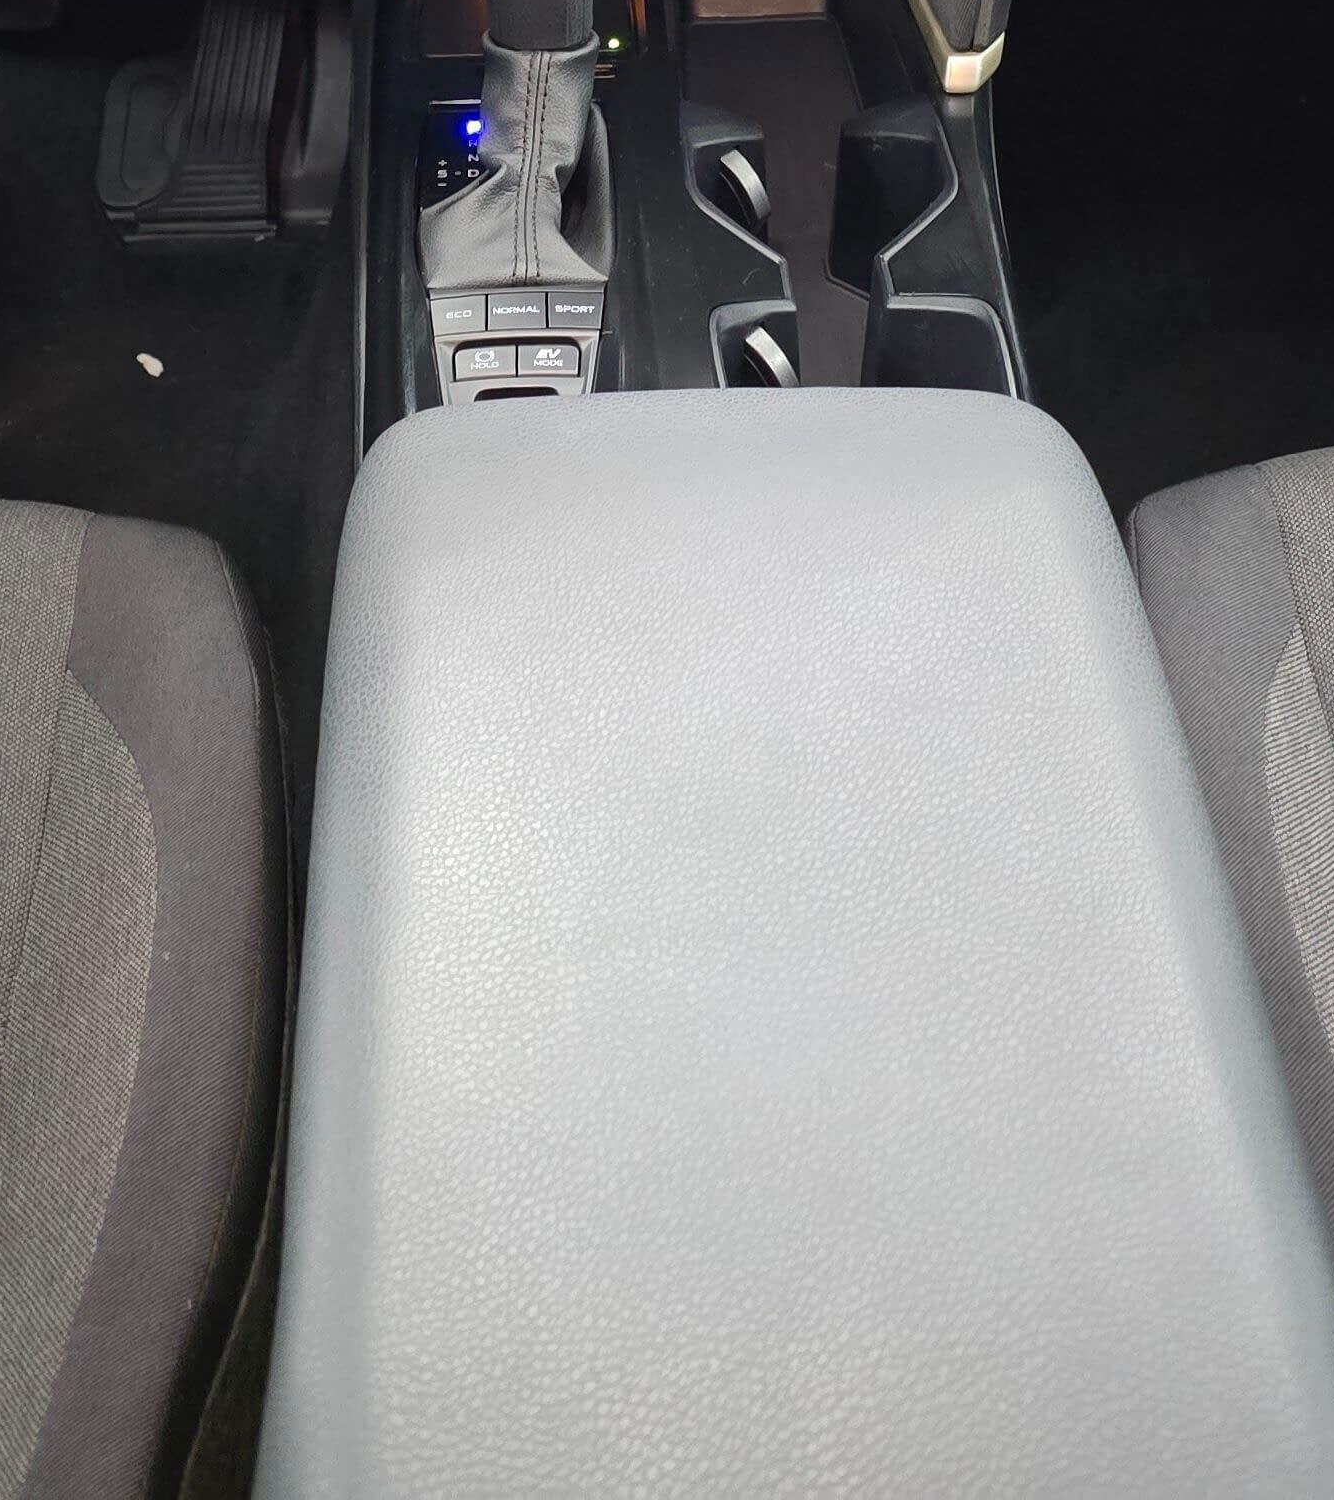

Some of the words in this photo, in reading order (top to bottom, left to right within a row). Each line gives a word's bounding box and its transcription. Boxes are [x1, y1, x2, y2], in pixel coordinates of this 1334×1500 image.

[467, 169, 480, 178] D
[445, 309, 472, 319] ECO
[492, 305, 540, 315] NORMAL
[554, 304, 596, 314] SPORT
[535, 348, 562, 359] EV
[470, 361, 500, 370] HOLD
[533, 359, 564, 367] MODE
